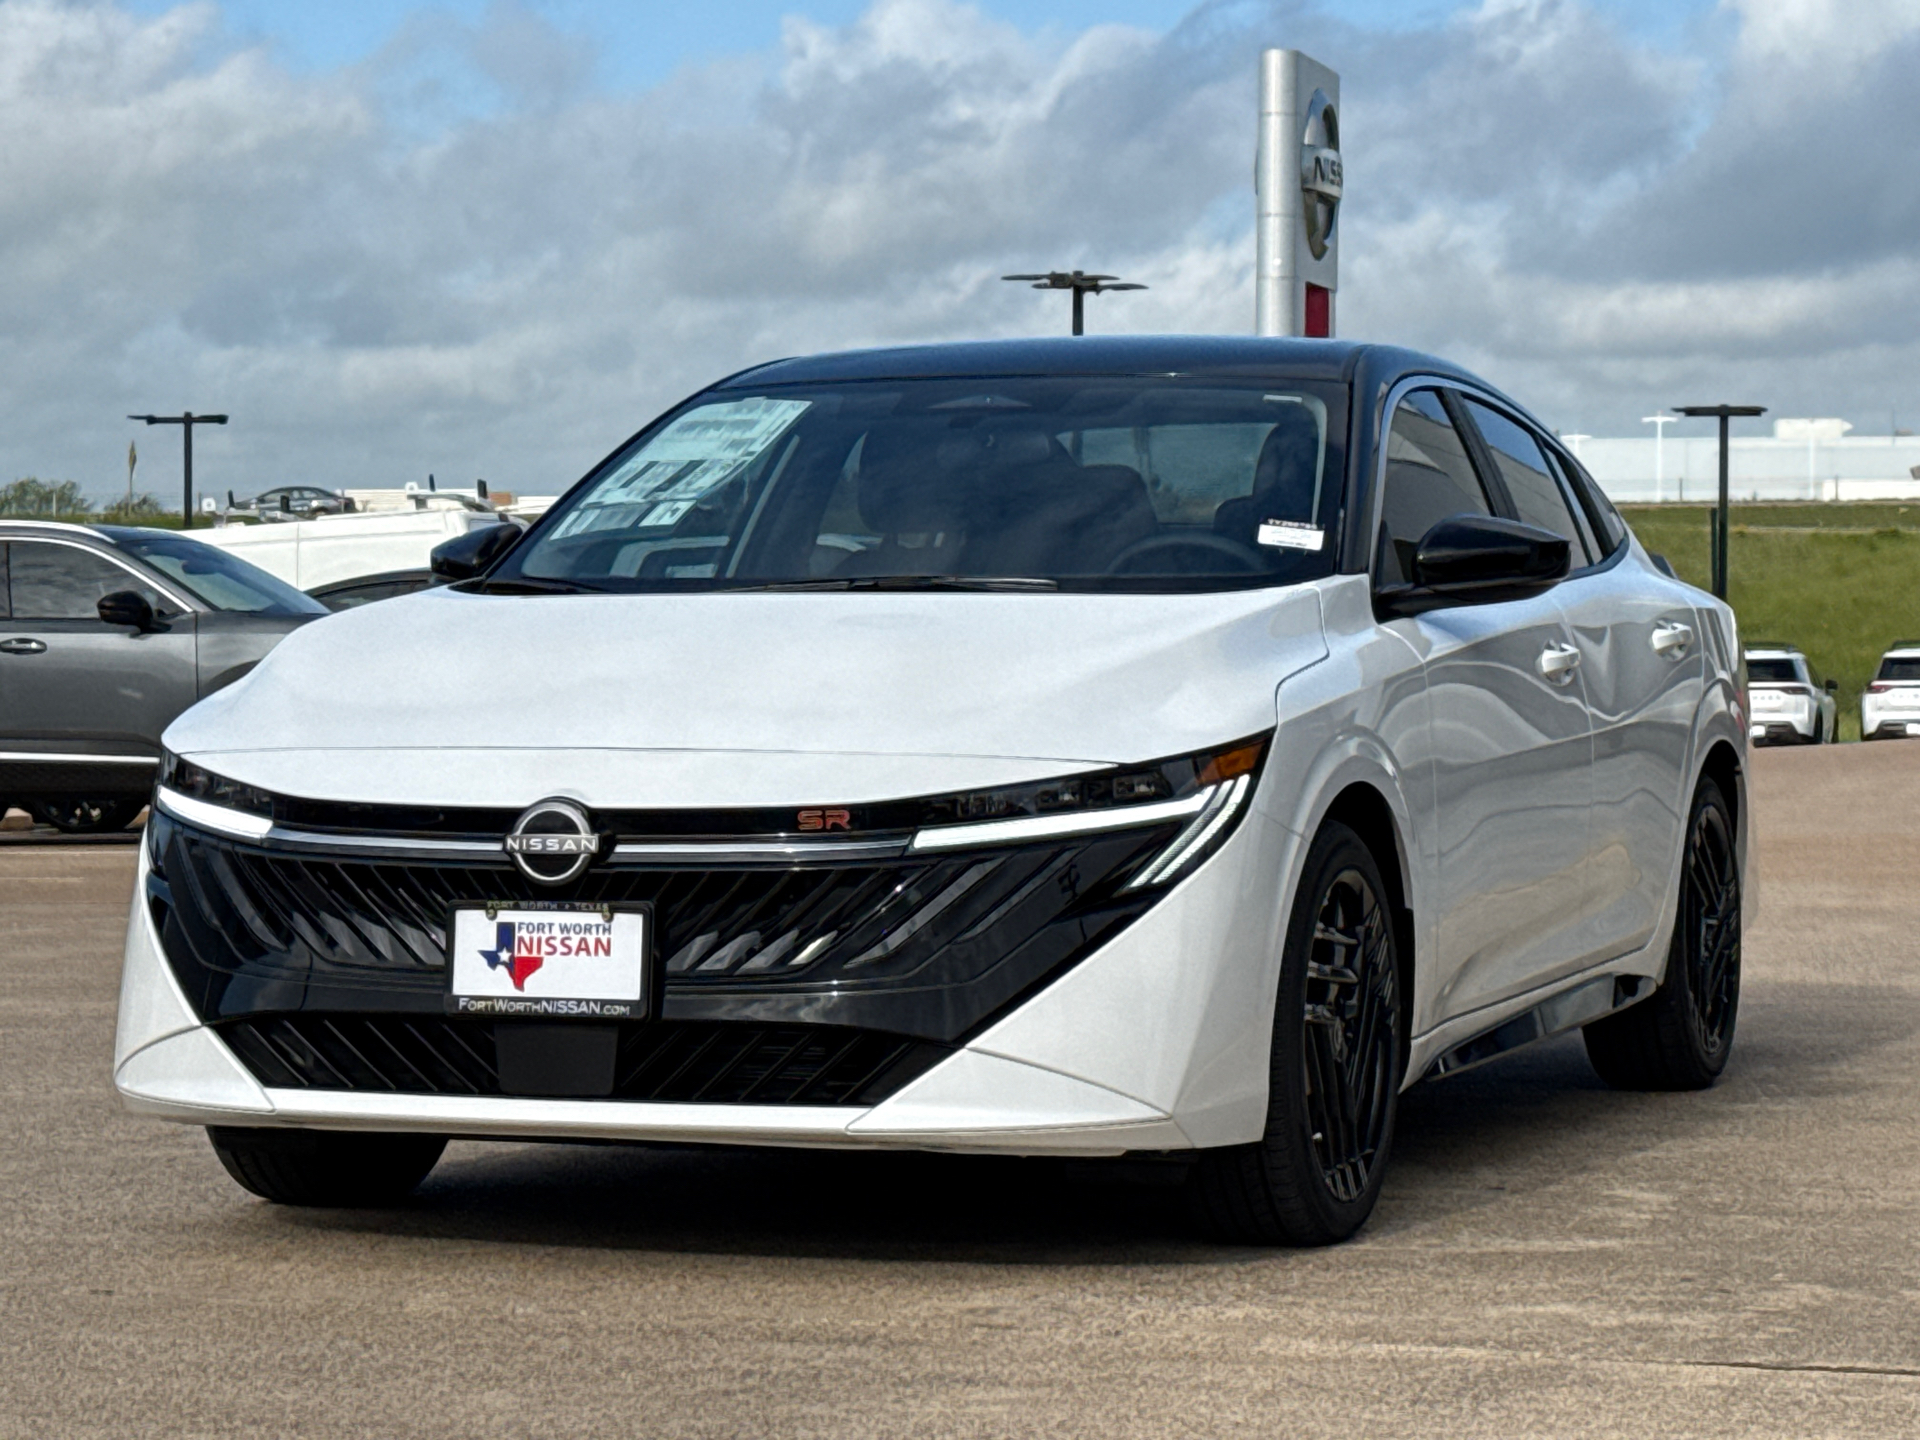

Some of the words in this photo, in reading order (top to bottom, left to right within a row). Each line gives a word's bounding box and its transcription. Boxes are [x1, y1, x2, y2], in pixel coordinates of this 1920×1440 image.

[1314, 155, 1343, 187] NISS
[797, 810, 851, 830] SR
[506, 837, 597, 852] NISSAN
[520, 901, 558, 910] WORTH
[573, 902, 609, 911] TEXAS
[517, 922, 555, 934] FORT
[559, 922, 612, 936] WORTH
[517, 935, 611, 957] NISSAN
